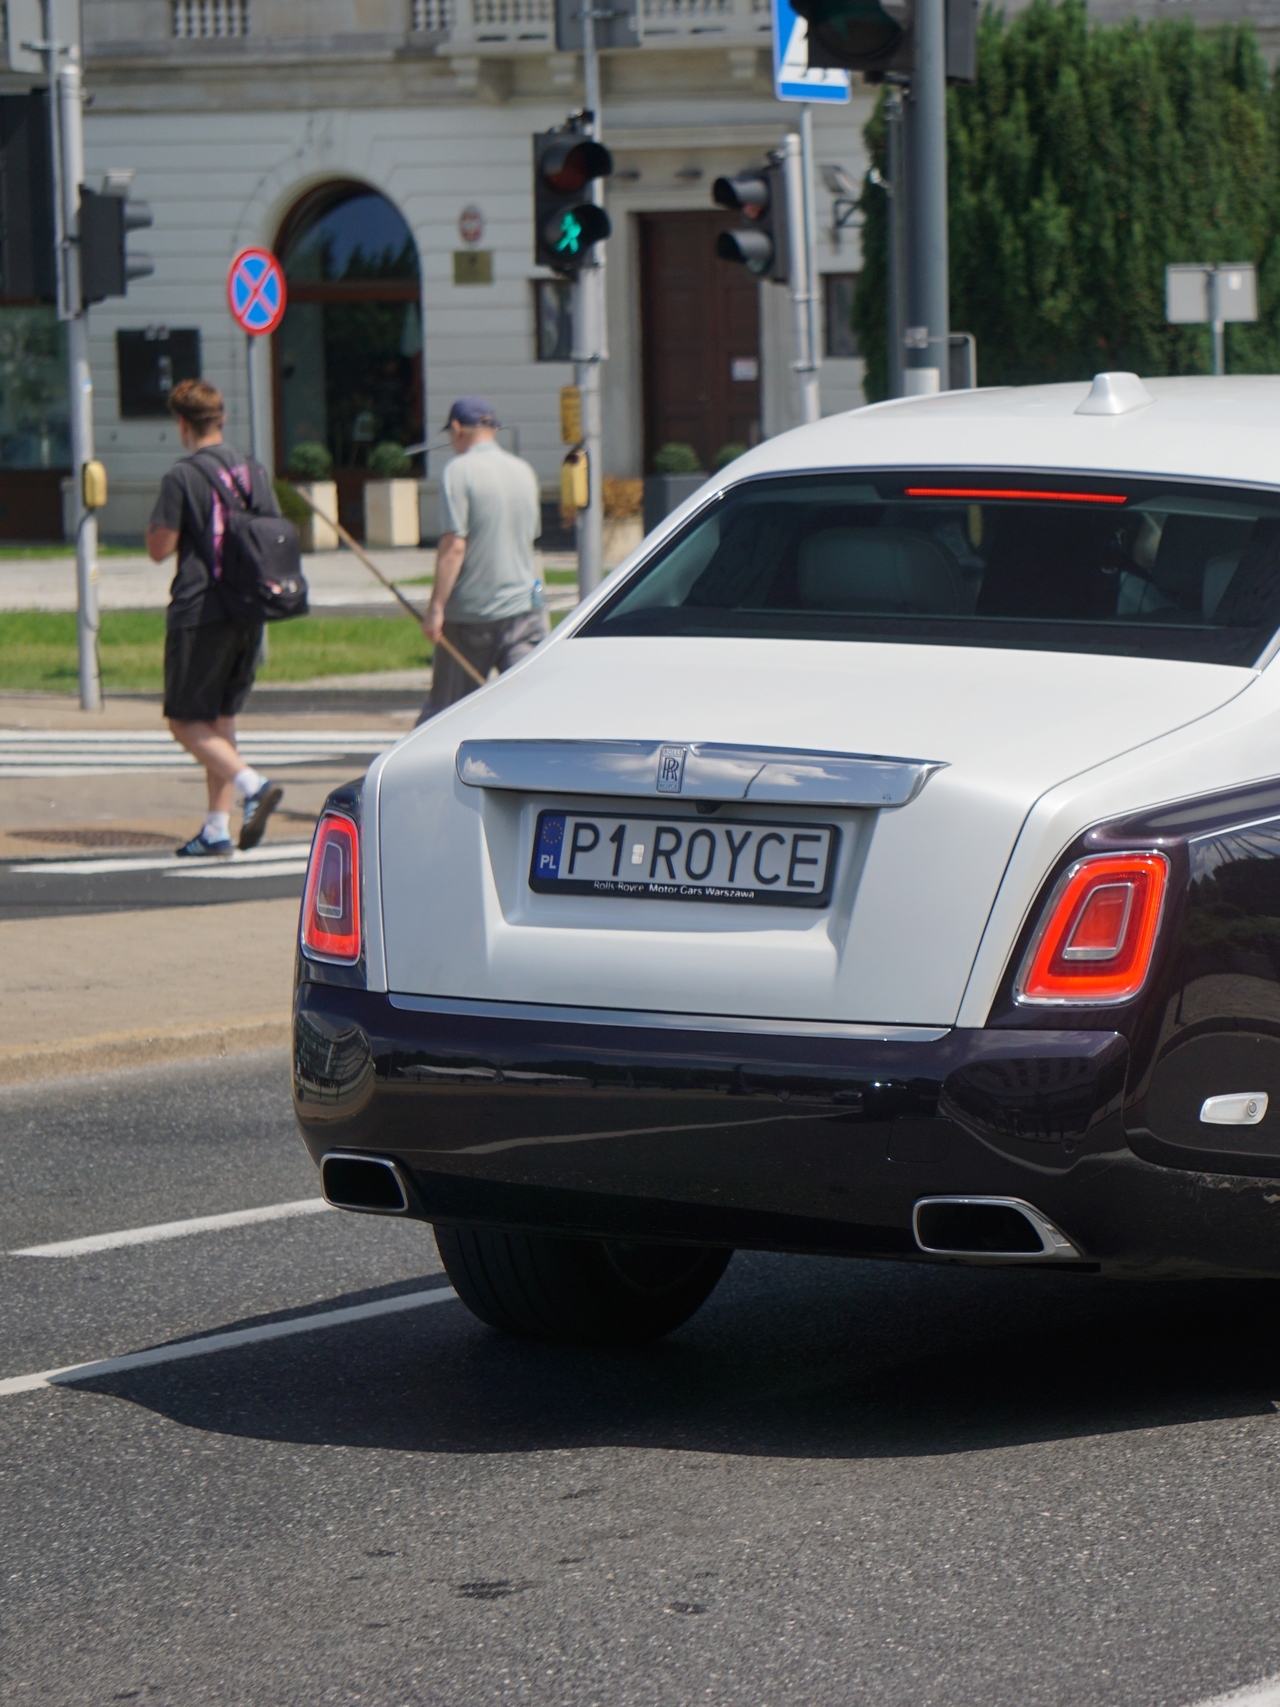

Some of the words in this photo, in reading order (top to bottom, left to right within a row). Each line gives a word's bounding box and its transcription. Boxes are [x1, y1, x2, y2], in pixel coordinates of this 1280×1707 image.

[540, 854, 557, 870] PL
[568, 822, 626, 877] P1
[649, 826, 822, 888] ROYCE
[649, 884, 678, 894] Motor
[680, 885, 703, 896] Cars
[705, 887, 755, 899] Warszawa
